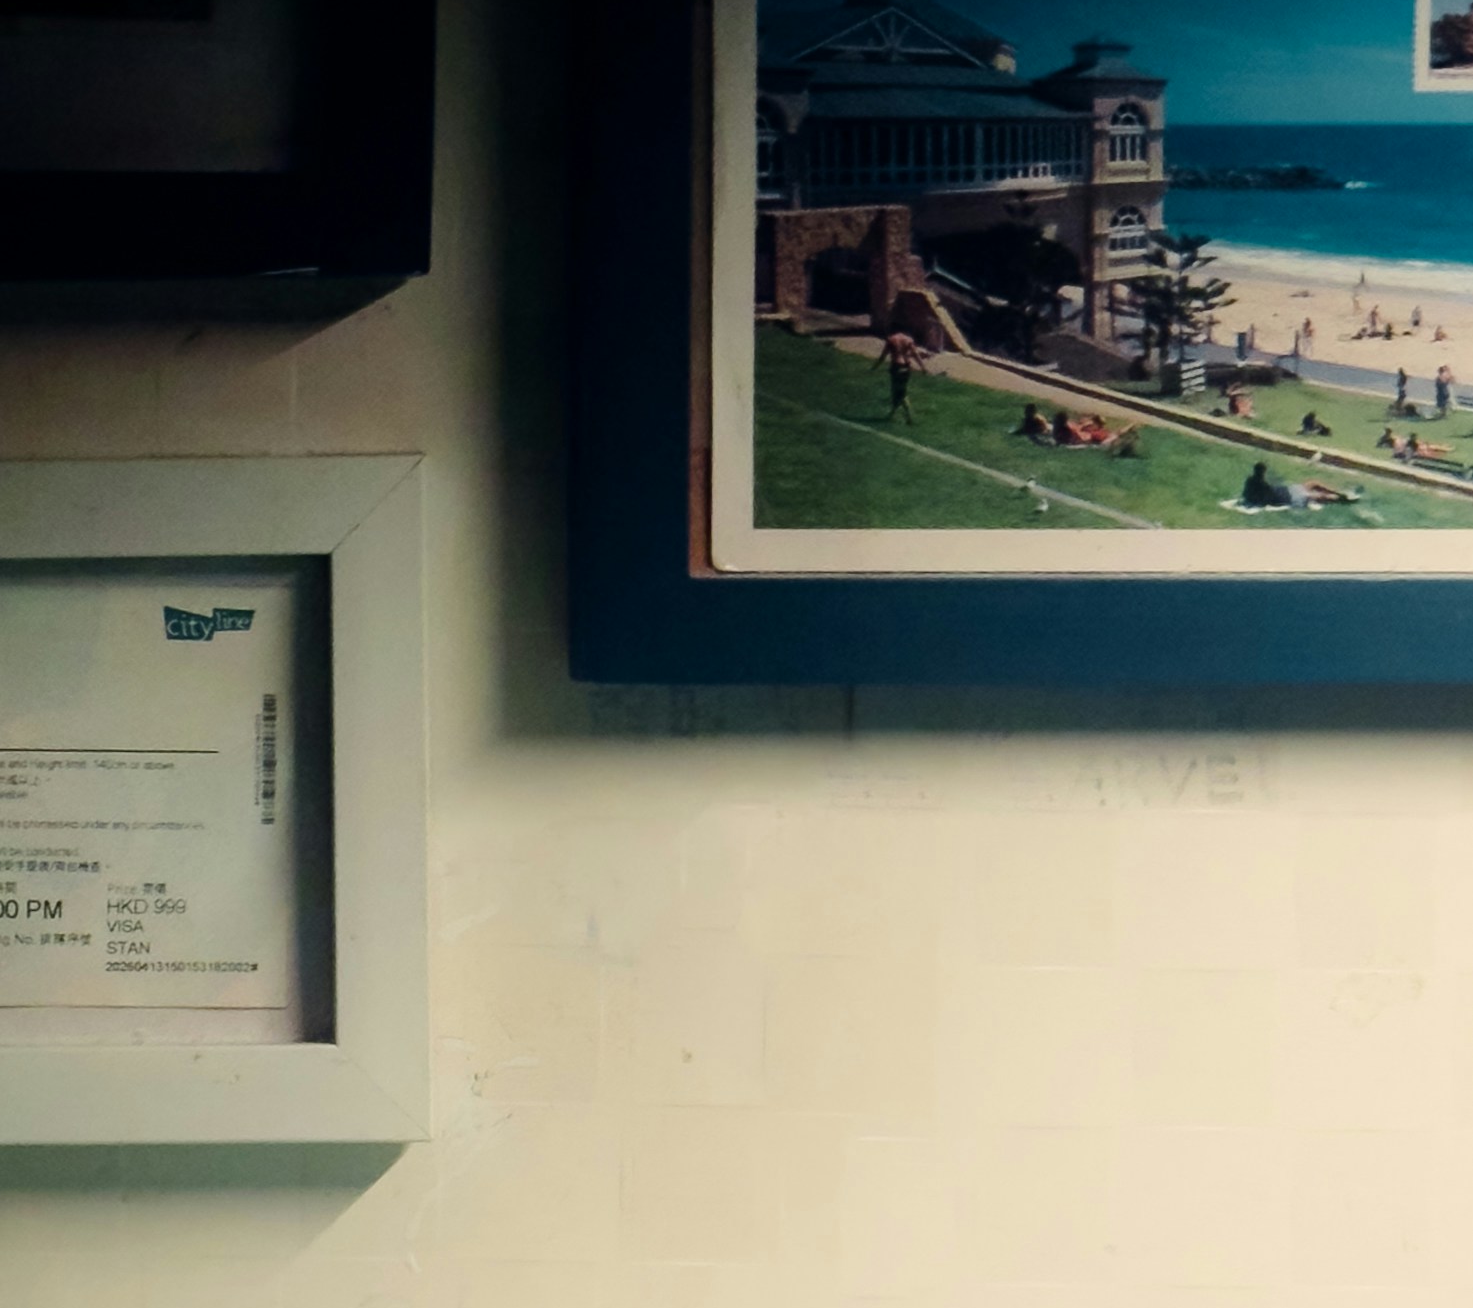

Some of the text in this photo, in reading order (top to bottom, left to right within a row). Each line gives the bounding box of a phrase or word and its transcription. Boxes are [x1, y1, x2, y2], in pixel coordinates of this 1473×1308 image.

[166, 610, 250, 640] cityline
[26, 900, 63, 919] PM
[107, 898, 187, 914] HKD 999
[107, 919, 144, 933] VISA
[107, 941, 151, 955] STAN
